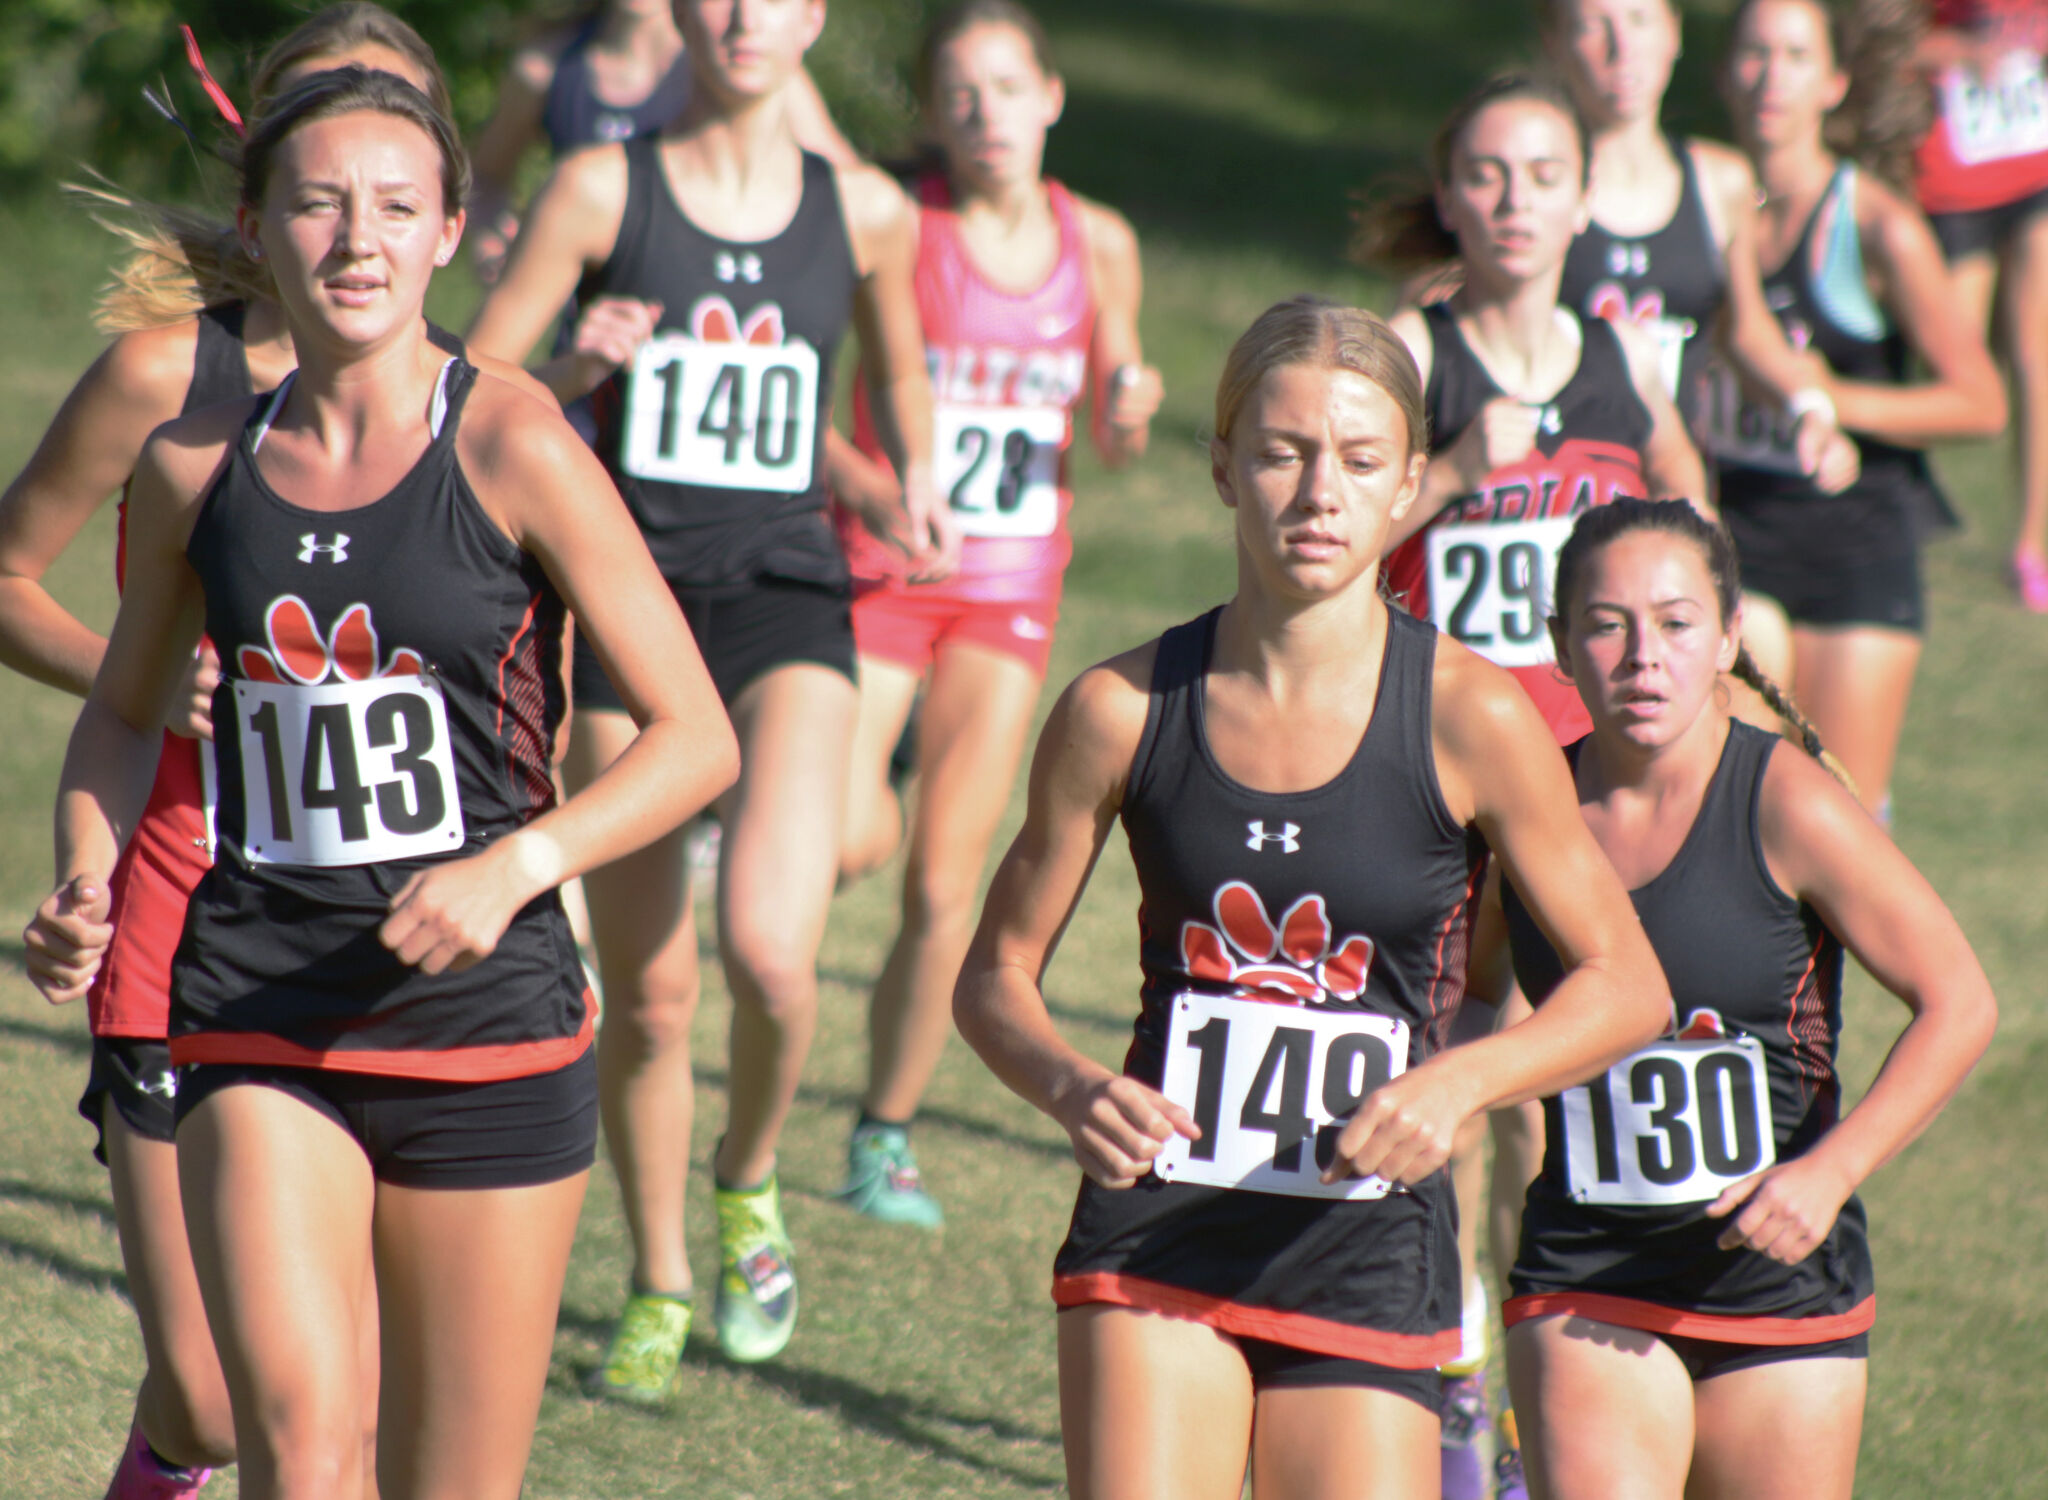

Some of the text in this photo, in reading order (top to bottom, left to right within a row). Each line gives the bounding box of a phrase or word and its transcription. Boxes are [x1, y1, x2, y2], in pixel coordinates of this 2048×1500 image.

[654, 357, 802, 470] 140
[1444, 541, 1558, 646] 29
[250, 692, 446, 843] 143
[1187, 1016, 1392, 1181] 149
[1587, 1052, 1762, 1186] 130
